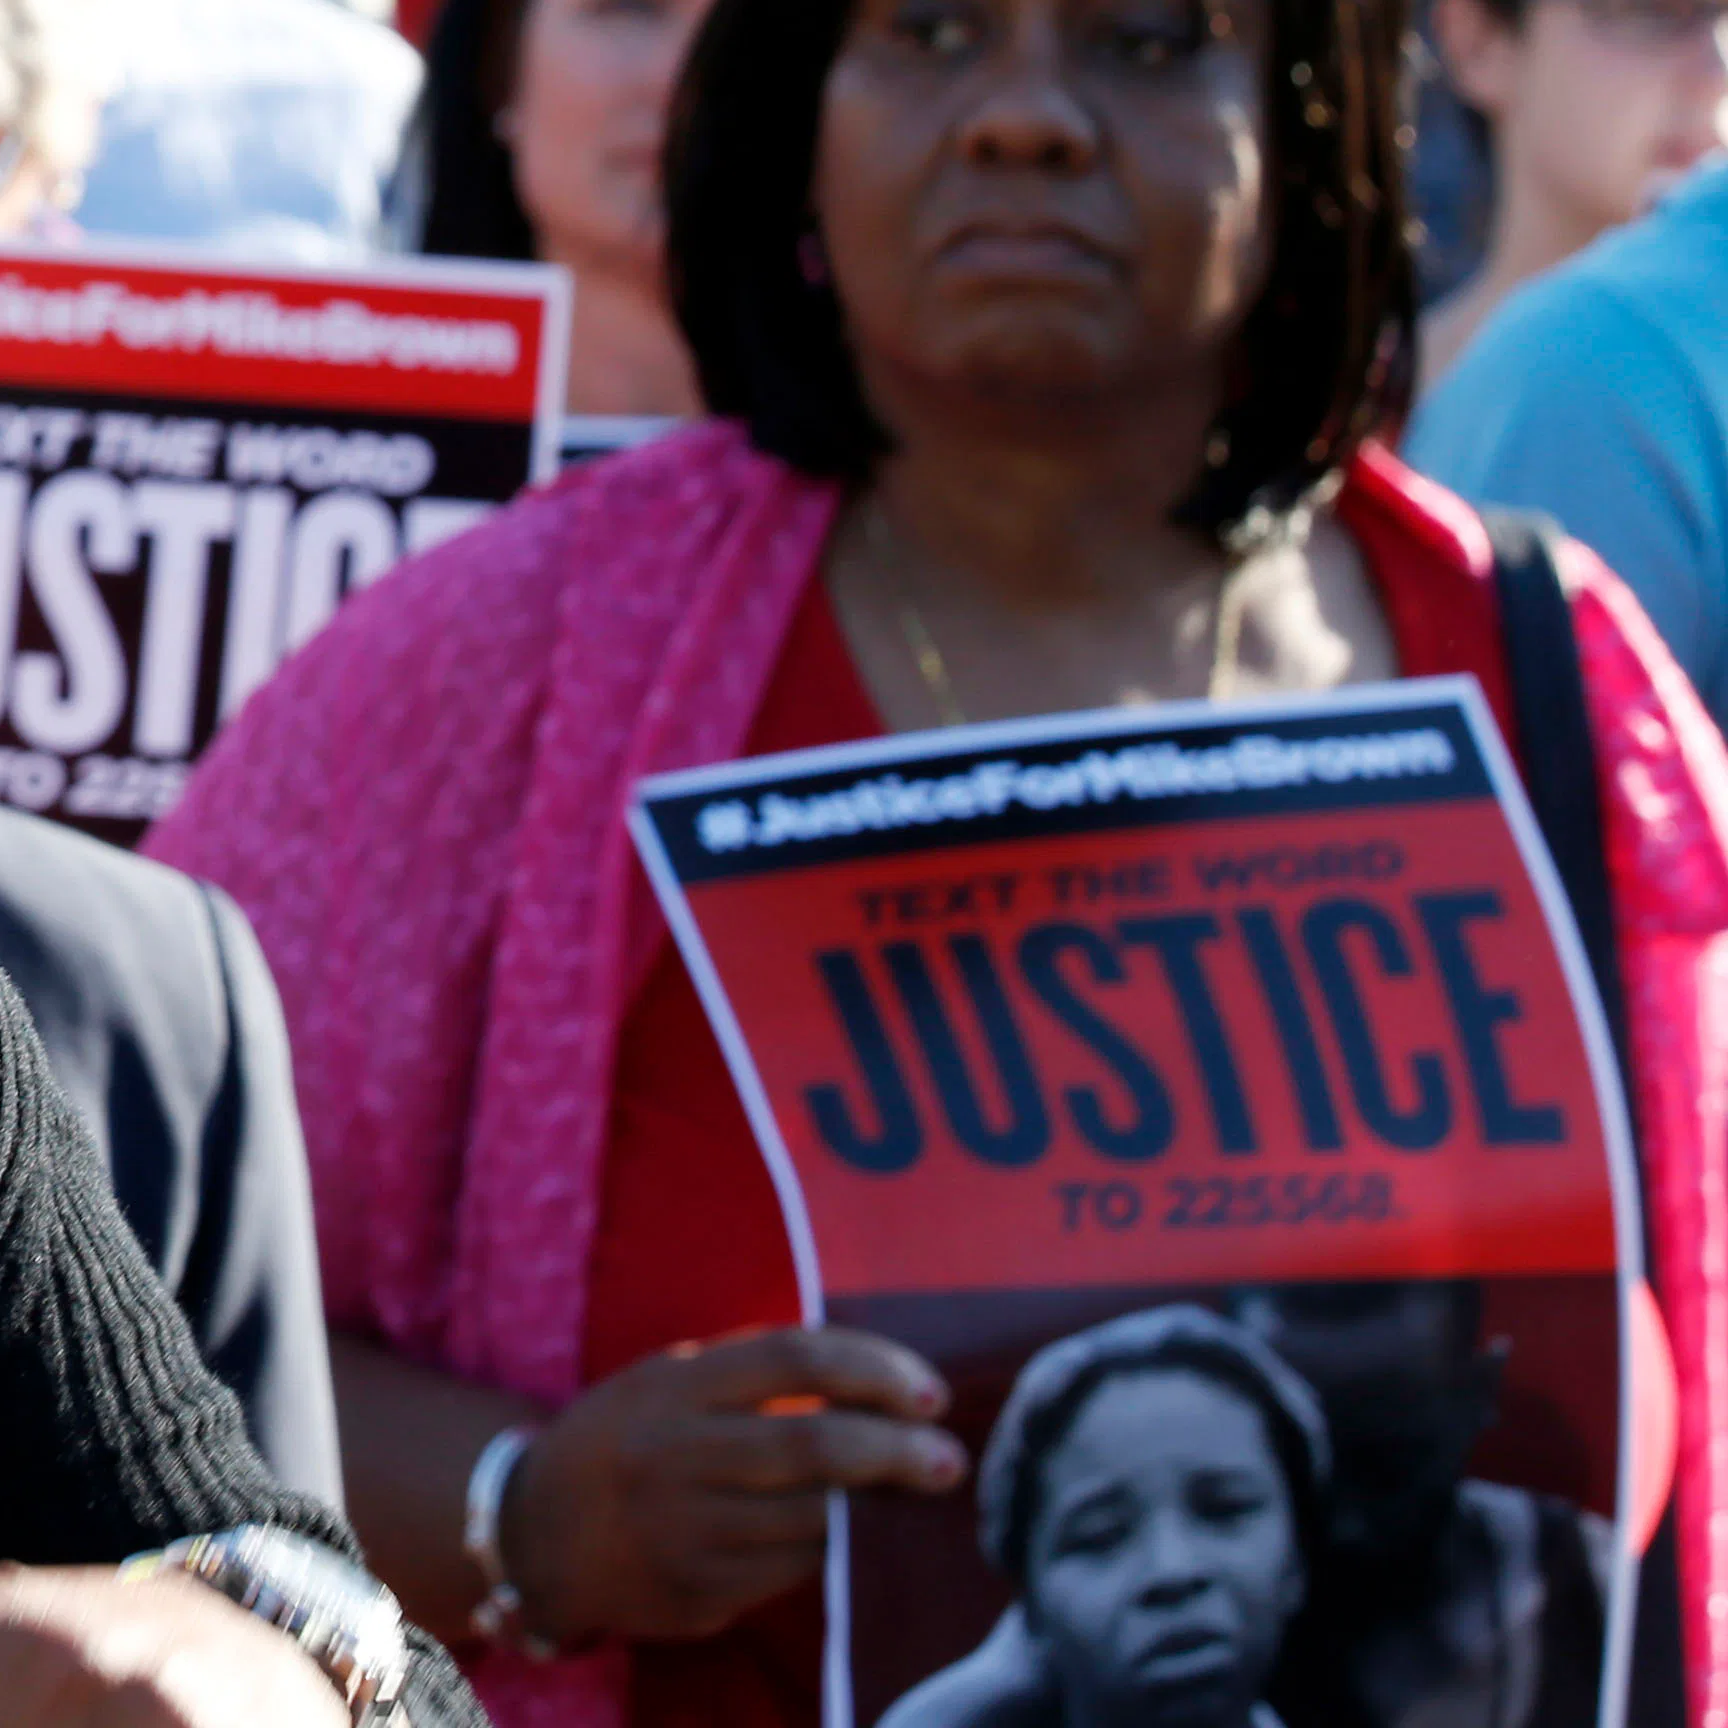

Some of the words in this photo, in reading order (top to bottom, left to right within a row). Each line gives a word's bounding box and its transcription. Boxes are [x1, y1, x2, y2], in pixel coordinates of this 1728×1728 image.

[90, 408, 224, 478] THE
[226, 420, 437, 496] WORD
[698, 727, 1455, 854] #JusticeForMikeBrown
[857, 874, 1019, 929] TEXT
[1052, 850, 1176, 906] THE
[1194, 838, 1408, 899] WORD
[801, 887, 1571, 1177] JUSTICE
[1057, 1179, 1143, 1234] TO
